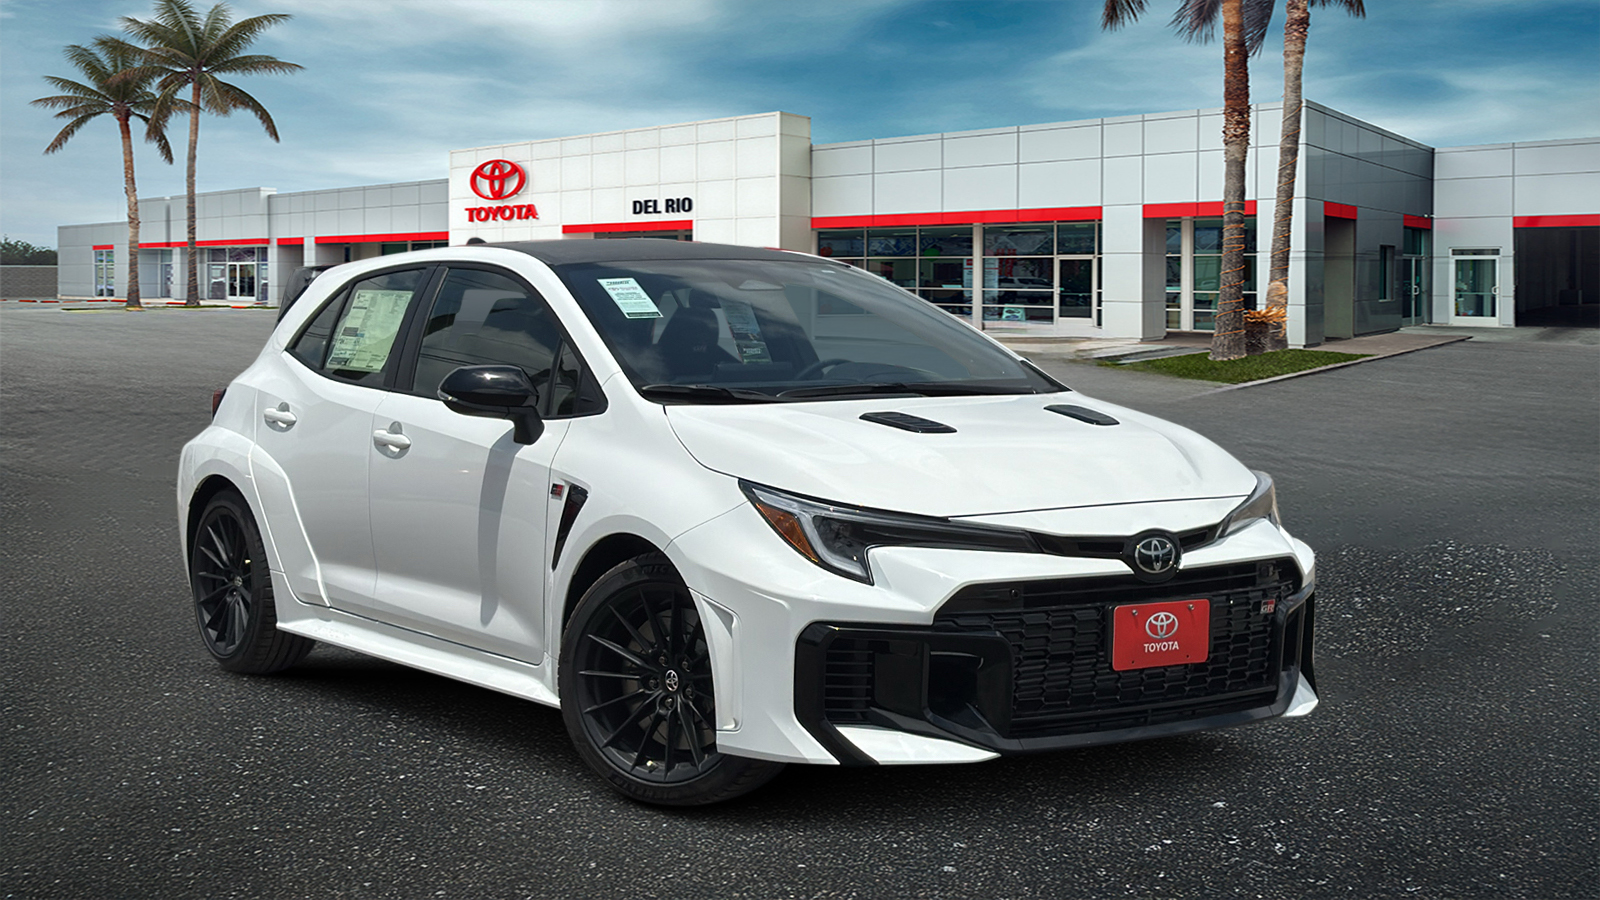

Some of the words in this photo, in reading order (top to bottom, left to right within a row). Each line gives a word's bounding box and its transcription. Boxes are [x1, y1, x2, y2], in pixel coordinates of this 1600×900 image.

[464, 203, 539, 222] TOYOTA
[632, 199, 662, 215] DEL
[665, 196, 693, 213] RIO
[1260, 602, 1275, 614] GR
[1143, 640, 1180, 653] TOYOTA
